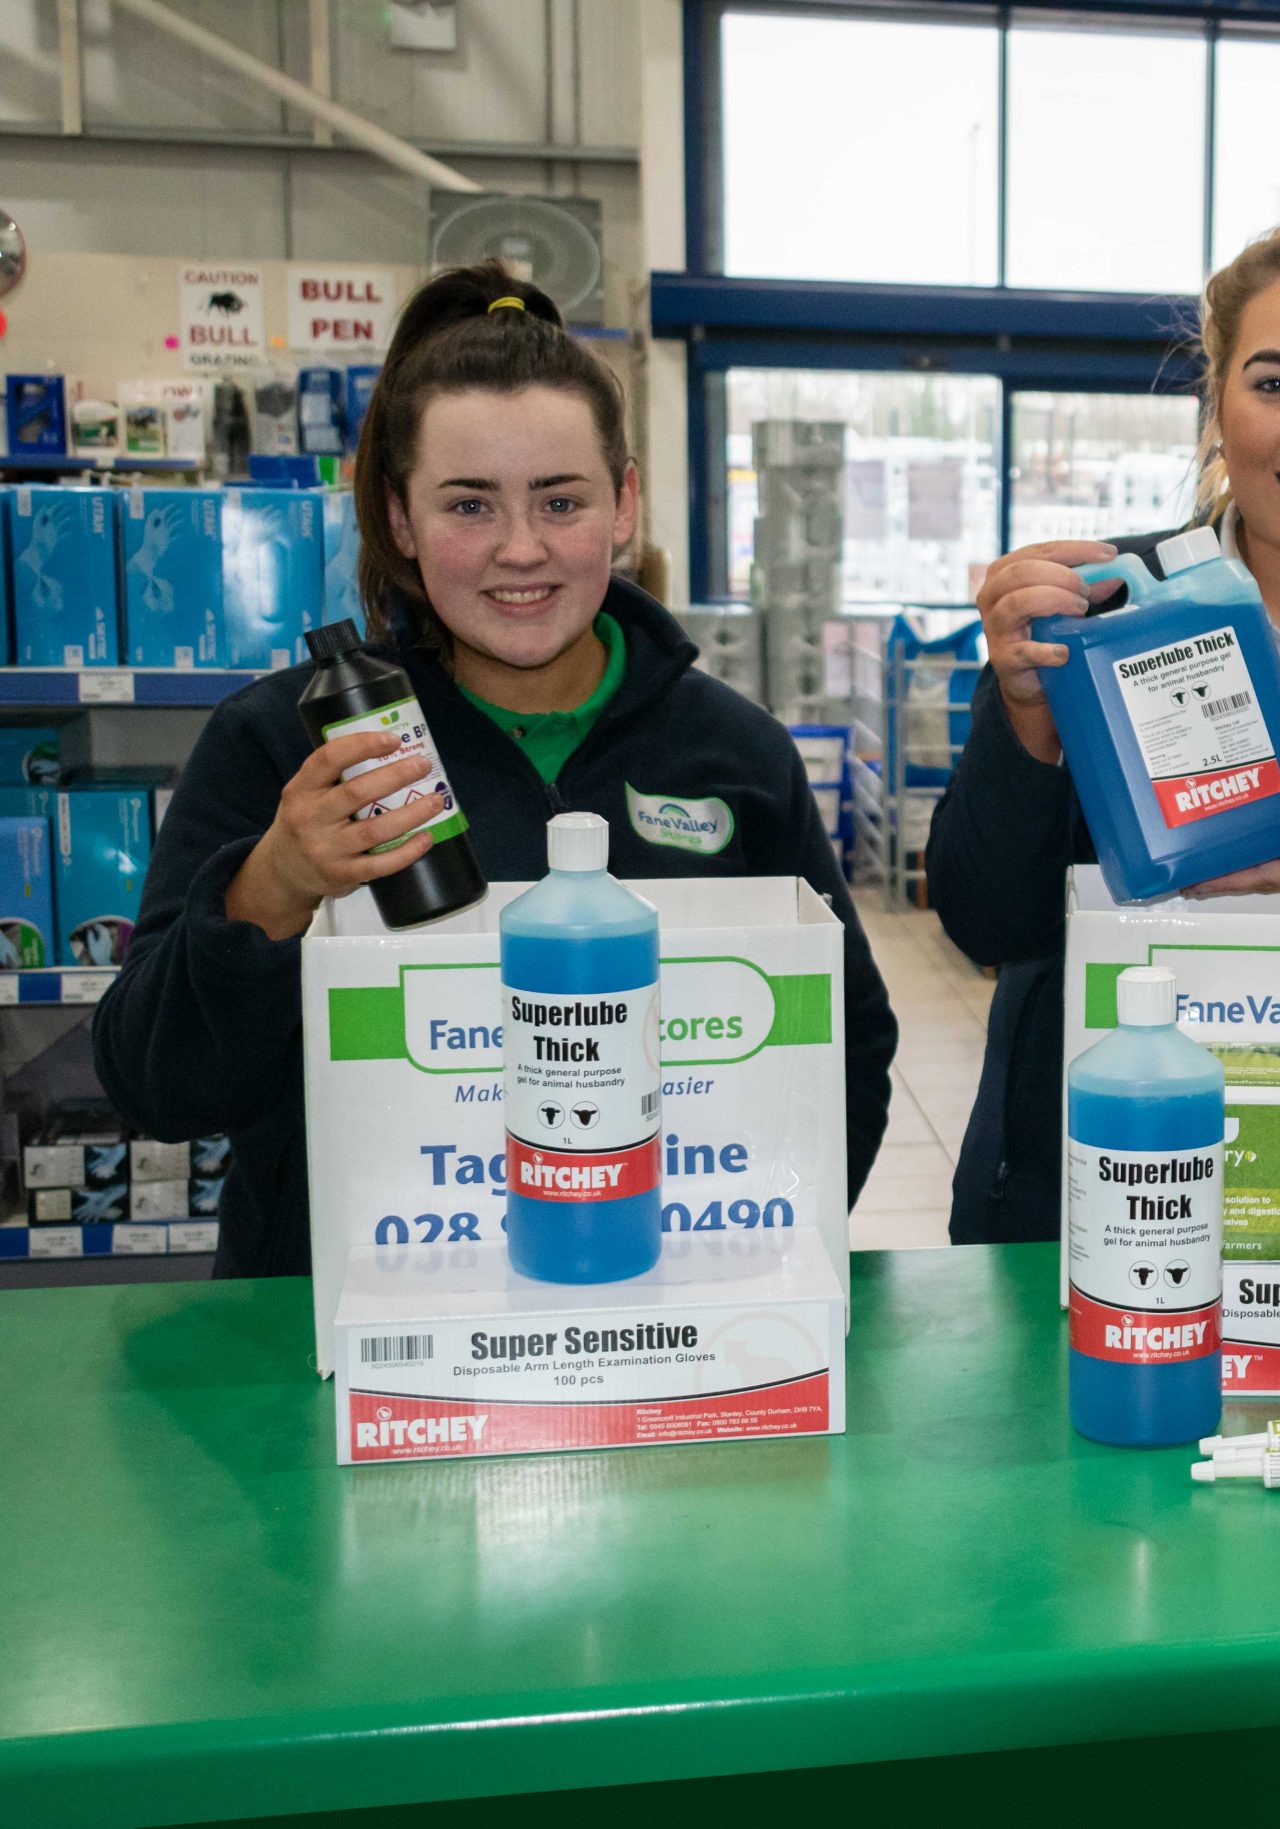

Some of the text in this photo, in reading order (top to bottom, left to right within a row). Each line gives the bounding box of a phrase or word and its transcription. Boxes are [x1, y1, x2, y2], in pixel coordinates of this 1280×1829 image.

[185, 271, 259, 285] CAUTION
[301, 278, 383, 303] BULL
[190, 324, 257, 346] BULL
[311, 318, 374, 340] PEN
[1119, 632, 1235, 679] Superlube Thick
[1140, 675, 1159, 685] thick
[1160, 665, 1188, 680] general
[1189, 656, 1219, 672] purpose
[1220, 651, 1232, 661] gel
[1148, 664, 1225, 693] for animal husbandry
[400, 741, 425, 754] Strong
[1202, 754, 1222, 767] 2.5L
[1175, 767, 1261, 813] RITCHEY
[512, 995, 628, 1027] Superlube
[659, 1015, 743, 1041] ores
[533, 1035, 600, 1063] Thick
[517, 1064, 622, 1078] A thick general purpose
[517, 1075, 625, 1089] gel for animal husbandry
[455, 1077, 714, 1103] Mak asier
[562, 1137, 573, 1145] 1L
[520, 1160, 625, 1189] RITCHEY
[1098, 1156, 1214, 1187] Superlube
[543, 1190, 602, 1199] www.ritchey.co.uk
[1226, 1195, 1271, 1204] solution to
[1126, 1194, 1192, 1221] Thick
[1229, 1207, 1246, 1216] and
[1103, 1234, 1211, 1247] gel for animal husbandry
[1105, 1223, 1209, 1238] A thick general purpose
[471, 1322, 698, 1361] Super Sensitive
[1105, 1320, 1207, 1350] RITCHEY
[453, 1353, 716, 1377] Disposable Arm Length Examination Gloves
[1133, 1350, 1190, 1359] www.ritchey.co.uk
[554, 1375, 604, 1388] 100 pcs
[356, 1414, 489, 1448] RITCHEY
[393, 1444, 464, 1456] www.ritchey.co.uk
